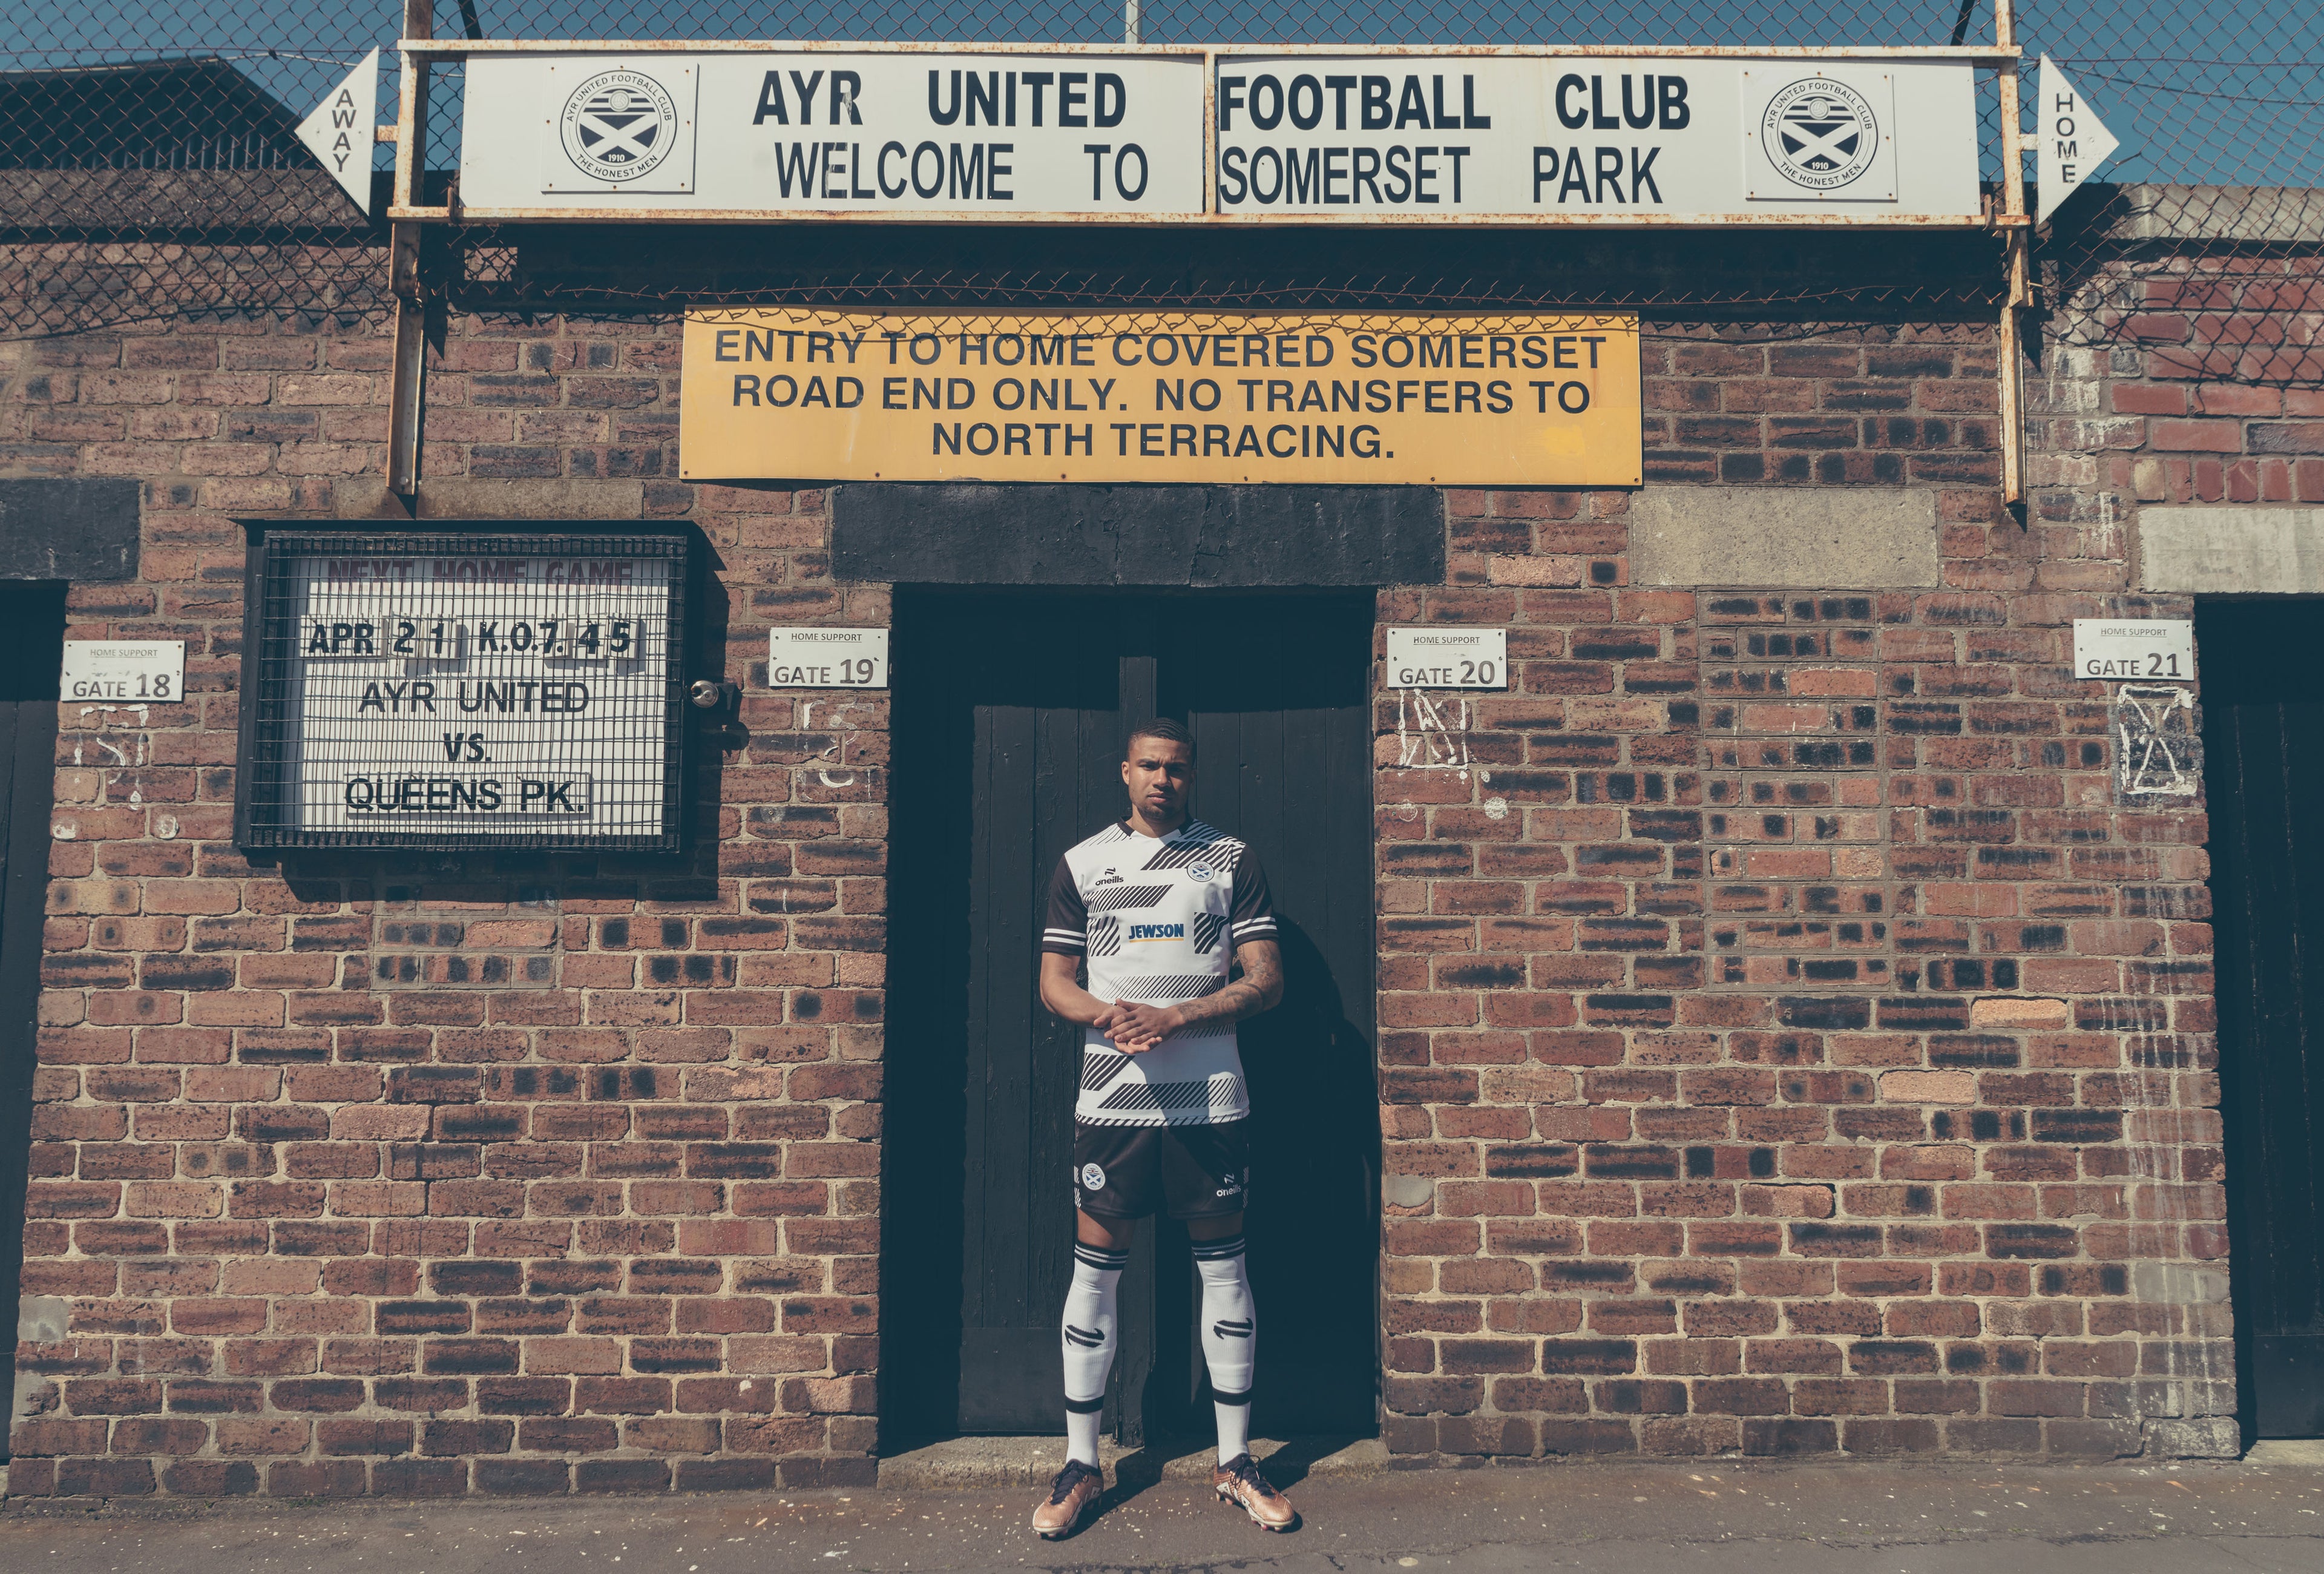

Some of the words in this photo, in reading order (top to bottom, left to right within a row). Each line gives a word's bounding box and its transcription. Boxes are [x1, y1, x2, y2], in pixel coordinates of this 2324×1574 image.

[566, 102, 579, 122] AYR
[576, 77, 608, 101] UNITED
[611, 75, 658, 96] FOOTBALL
[658, 96, 672, 121] CLUB
[753, 70, 862, 125] AYR
[928, 70, 1126, 127] UNITED
[1220, 74, 1491, 131] FOOTBALL
[1555, 74, 1690, 130] CLUB
[1767, 110, 1778, 128] AYR
[1775, 85, 1805, 108] UNITED
[1808, 82, 1856, 105] FOOTBALL
[1857, 105, 1872, 130] CLUB
[332, 89, 356, 173] AWAY
[2056, 93, 2076, 183] HOME
[577, 154, 594, 171] THE
[594, 166, 635, 177] HONEST
[637, 155, 658, 172] MEN
[608, 154, 625, 162] 1910
[775, 141, 1013, 200] WELCOME
[1084, 143, 1148, 201] TO
[1219, 145, 1470, 205] SOMERSET
[1534, 147, 1663, 203] PARK
[1781, 161, 1798, 178] THE
[1799, 174, 1839, 185] HONEST
[1842, 163, 1862, 180] MEN
[1811, 162, 1829, 170] 1910
[715, 330, 866, 363] ENTRY
[882, 332, 941, 365] TO
[960, 334, 1093, 366] HOME
[1113, 334, 1333, 367] COVERED
[1351, 335, 1606, 369] SOMERSET
[734, 375, 864, 408] ROAD
[883, 377, 975, 409] END
[993, 378, 1126, 410] ONLY.
[1157, 379, 1221, 411] NO
[1238, 380, 1512, 413] TRANSFERS
[1529, 381, 1589, 413] TO
[933, 423, 1092, 456] NORTH
[1110, 424, 1393, 458] TERRACING.
[328, 561, 413, 592] NEXT
[434, 561, 528, 592] HOME
[547, 561, 632, 592] GAME
[308, 623, 374, 654] APR
[775, 667, 831, 684] GATE
[840, 659, 873, 684] 19
[1400, 668, 1452, 684] GATE
[1460, 660, 1495, 684] 20
[2087, 660, 2140, 676] GATE
[2148, 653, 2181, 677] 21
[73, 681, 126, 697] GATE
[136, 674, 170, 697] 18
[358, 682, 436, 713] AYR
[459, 682, 589, 713] UNITED
[442, 733, 491, 762] VS.
[346, 779, 502, 811] QUEENS
[520, 780, 583, 812] PK.
[1129, 924, 1184, 939] JEWSON
